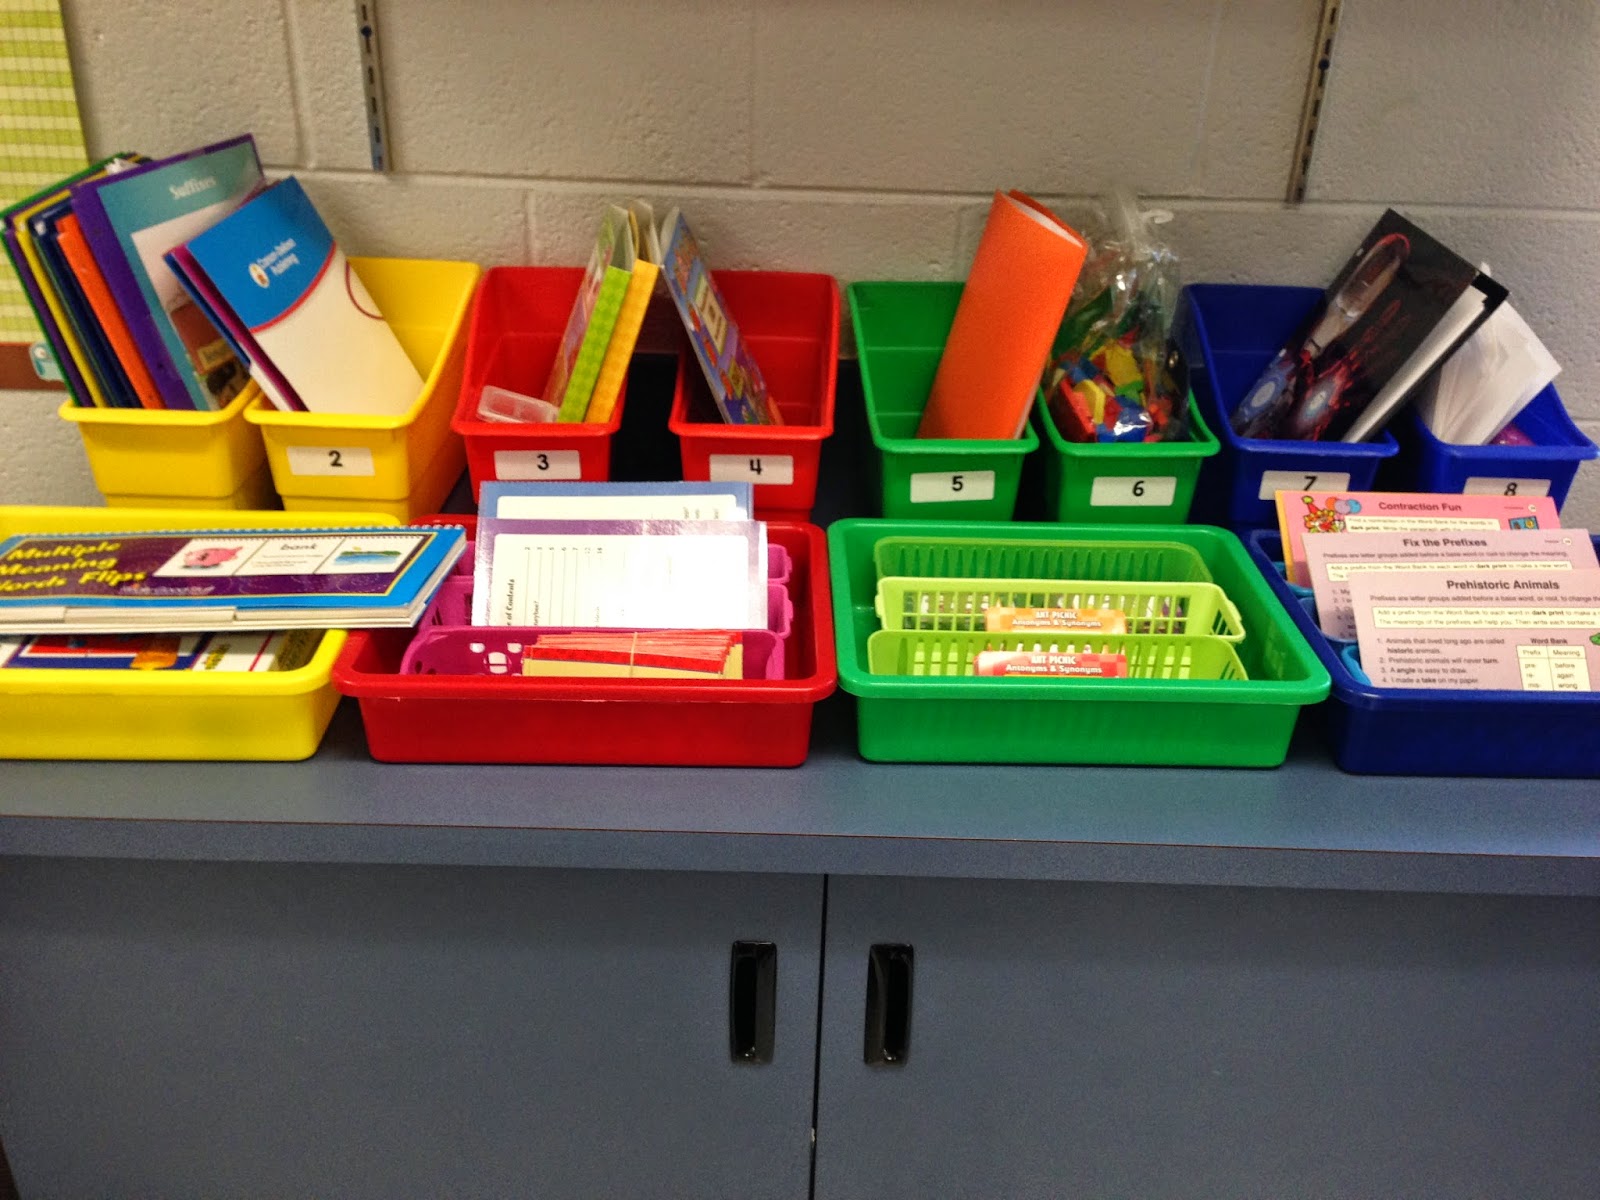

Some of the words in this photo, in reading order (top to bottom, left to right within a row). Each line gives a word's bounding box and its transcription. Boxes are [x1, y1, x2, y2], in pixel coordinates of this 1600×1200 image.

[328, 450, 343, 467] 2
[537, 454, 550, 470] 3
[750, 459, 762, 475] 4
[952, 476, 964, 492] 5
[1132, 480, 1144, 496] 6
[1304, 476, 1317, 491] 7
[1504, 483, 1517, 496] 8
[1378, 502, 1439, 511] Contraction
[1442, 502, 1462, 512] Fun
[7, 542, 122, 560] Multiple
[78, 570, 148, 586] Flips
[1446, 580, 1510, 589] Prehistoric
[1513, 580, 1560, 589] Animals
[506, 579, 515, 611] Contents
[1006, 664, 1047, 673] Antonyms
